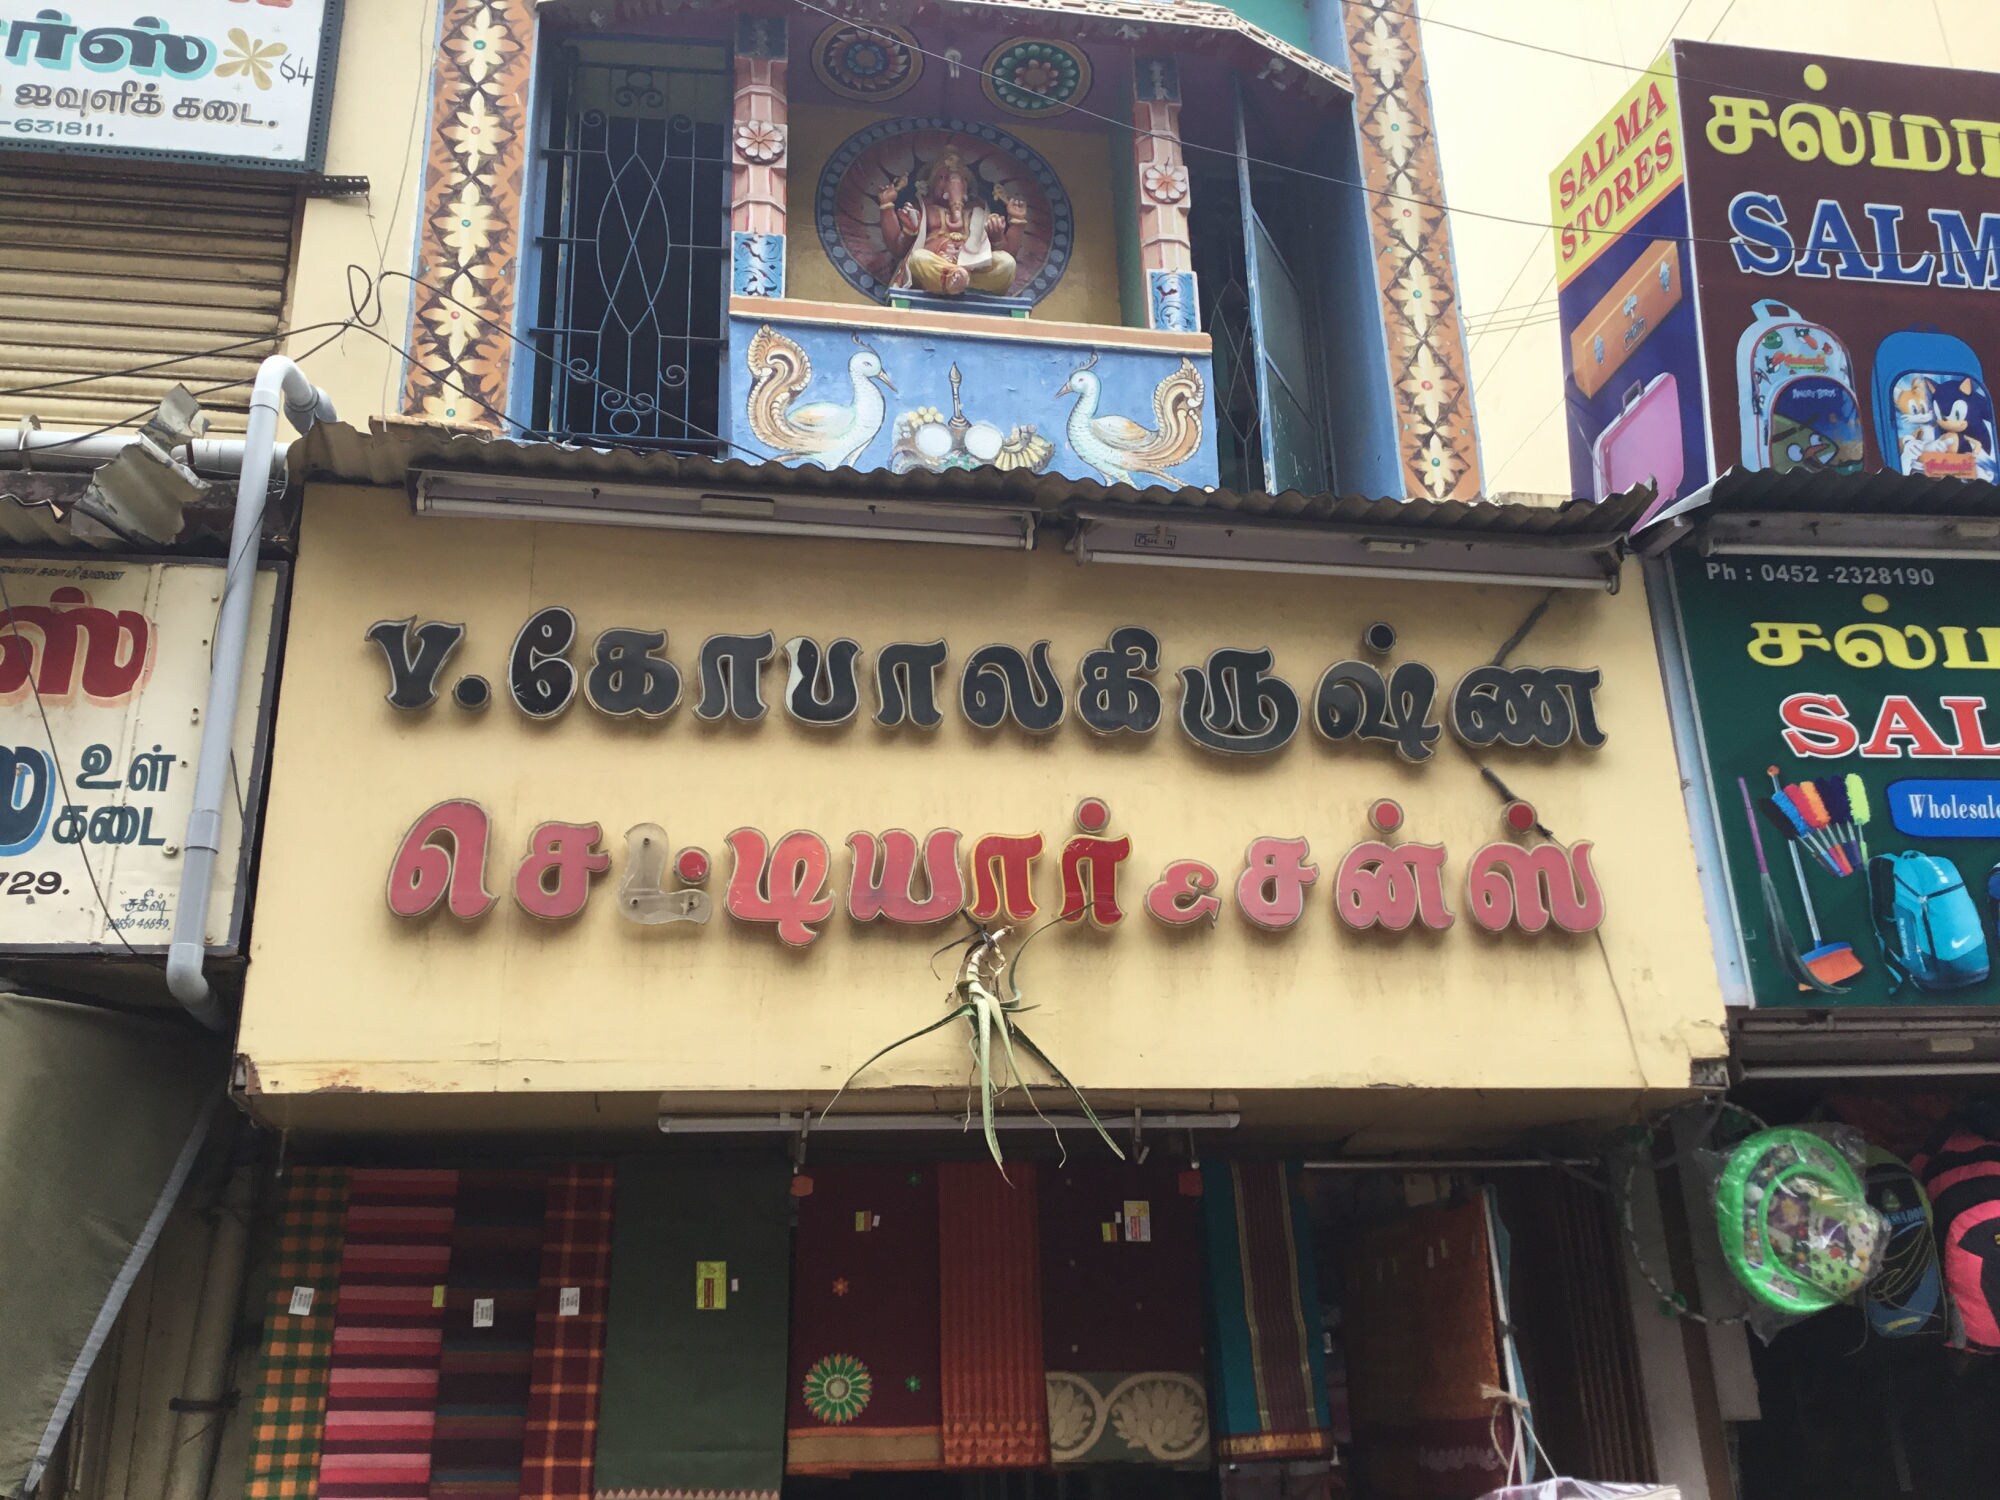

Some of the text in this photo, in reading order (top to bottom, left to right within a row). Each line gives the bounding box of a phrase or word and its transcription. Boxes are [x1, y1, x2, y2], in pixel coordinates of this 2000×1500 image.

[0, 8, 217, 81] ர்ஸ்
[14, 80, 165, 118] ஜவுளிக்
[1559, 79, 1669, 212] SALMA
[1561, 127, 1676, 264] STORES
[1706, 563, 1737, 581] Ph
[1761, 564, 1819, 583] 0452
[1827, 566, 1935, 586] -2328190
[75, 743, 177, 793] உள்
[51, 804, 167, 847] கடை
